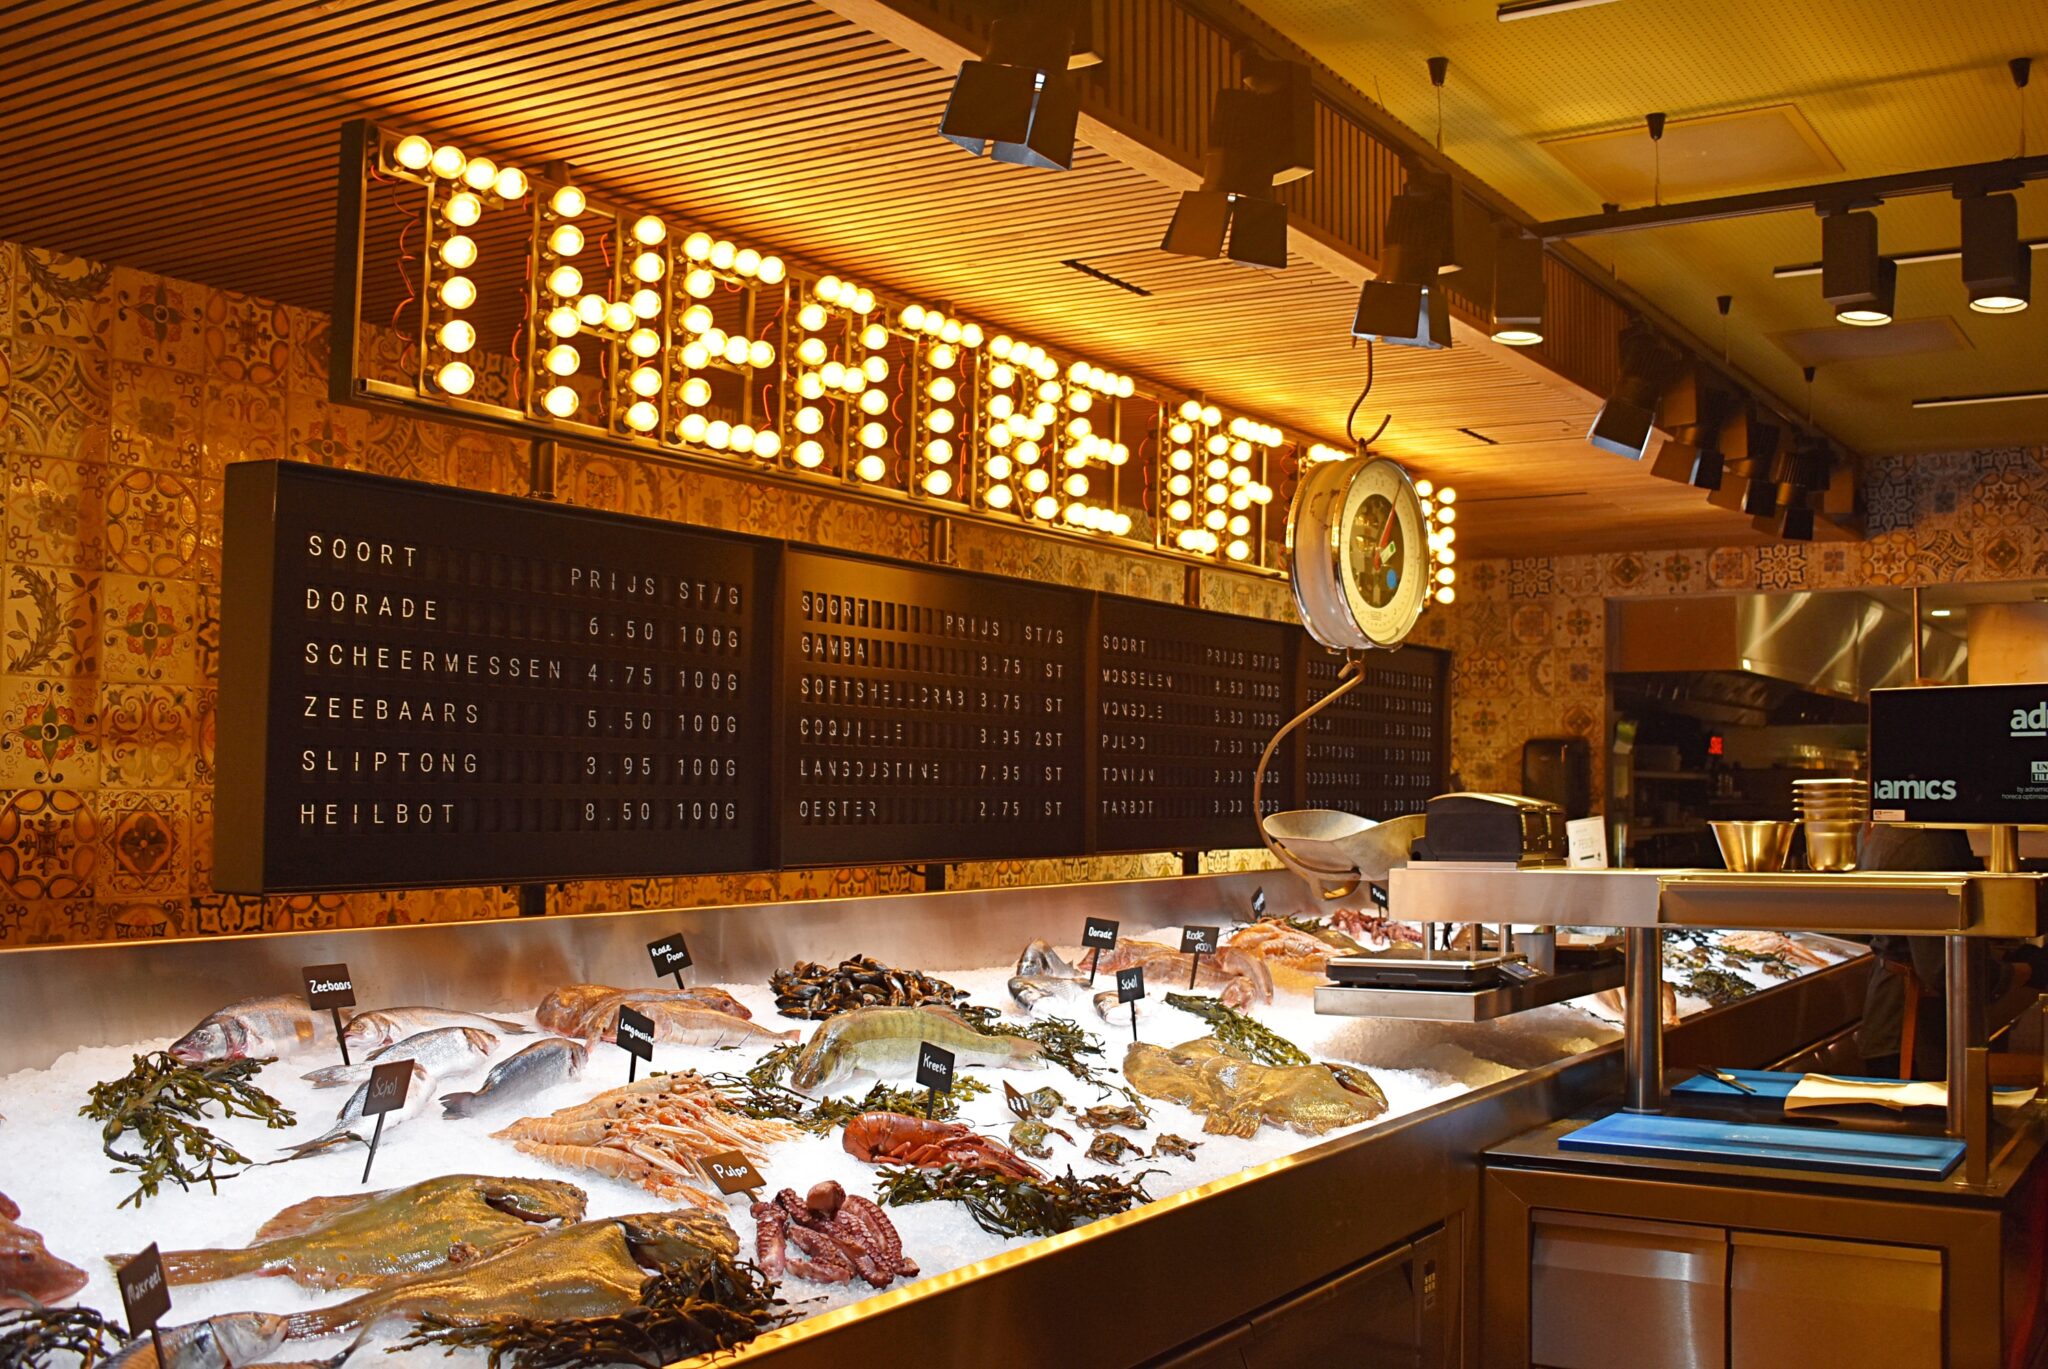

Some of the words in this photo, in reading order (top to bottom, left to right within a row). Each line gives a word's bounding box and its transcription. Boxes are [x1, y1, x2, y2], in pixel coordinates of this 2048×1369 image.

[394, 134, 1134, 537] THEATRE
[309, 535, 418, 567] SOORT
[571, 568, 656, 596] PRIJS
[680, 583, 738, 606] ST/G
[307, 589, 437, 621] DORADE
[589, 618, 654, 641] 6.50
[681, 626, 737, 648] 100G
[802, 596, 865, 620] SOORT
[946, 616, 1000, 637] PRIJS
[1103, 635, 1146, 653] SOORT
[305, 643, 561, 680] SCHEERMESSEN
[588, 663, 652, 686] 4.75
[680, 670, 737, 692] 100G
[802, 636, 864, 658] GAMBA
[981, 657, 1020, 674] 3.75
[1046, 664, 1062, 678] ST
[1103, 669, 1172, 688] MOSSELEN
[801, 678, 964, 705] SOFTSHECRAB
[981, 693, 1020, 710] 3.75
[1046, 698, 1062, 712] ST
[305, 696, 479, 724] ZEEBAARS
[588, 709, 652, 730] 5.50
[679, 715, 736, 734] 100G
[1103, 702, 1162, 719] VONGOE
[2011, 702, 2048, 729] ad
[800, 719, 902, 740] COQUIE
[1035, 732, 1062, 747] 2ST
[1253, 742, 1279, 755] 10G
[302, 750, 478, 774] SLIPTONG
[586, 757, 651, 776] 3.95
[678, 758, 735, 777] 100G
[1045, 767, 1062, 781] ST
[301, 803, 455, 825] HEILBOT
[585, 803, 650, 822] 8.50
[677, 803, 735, 821] 100G
[800, 800, 876, 817] OESTER
[980, 802, 1019, 816] 2.75
[1045, 802, 1061, 815] ST
[309, 979, 352, 994] Zeebaars
[923, 1053, 948, 1075] Kreeft
[372, 1076, 398, 1098] Schol
[713, 1164, 748, 1179] Pulpo
